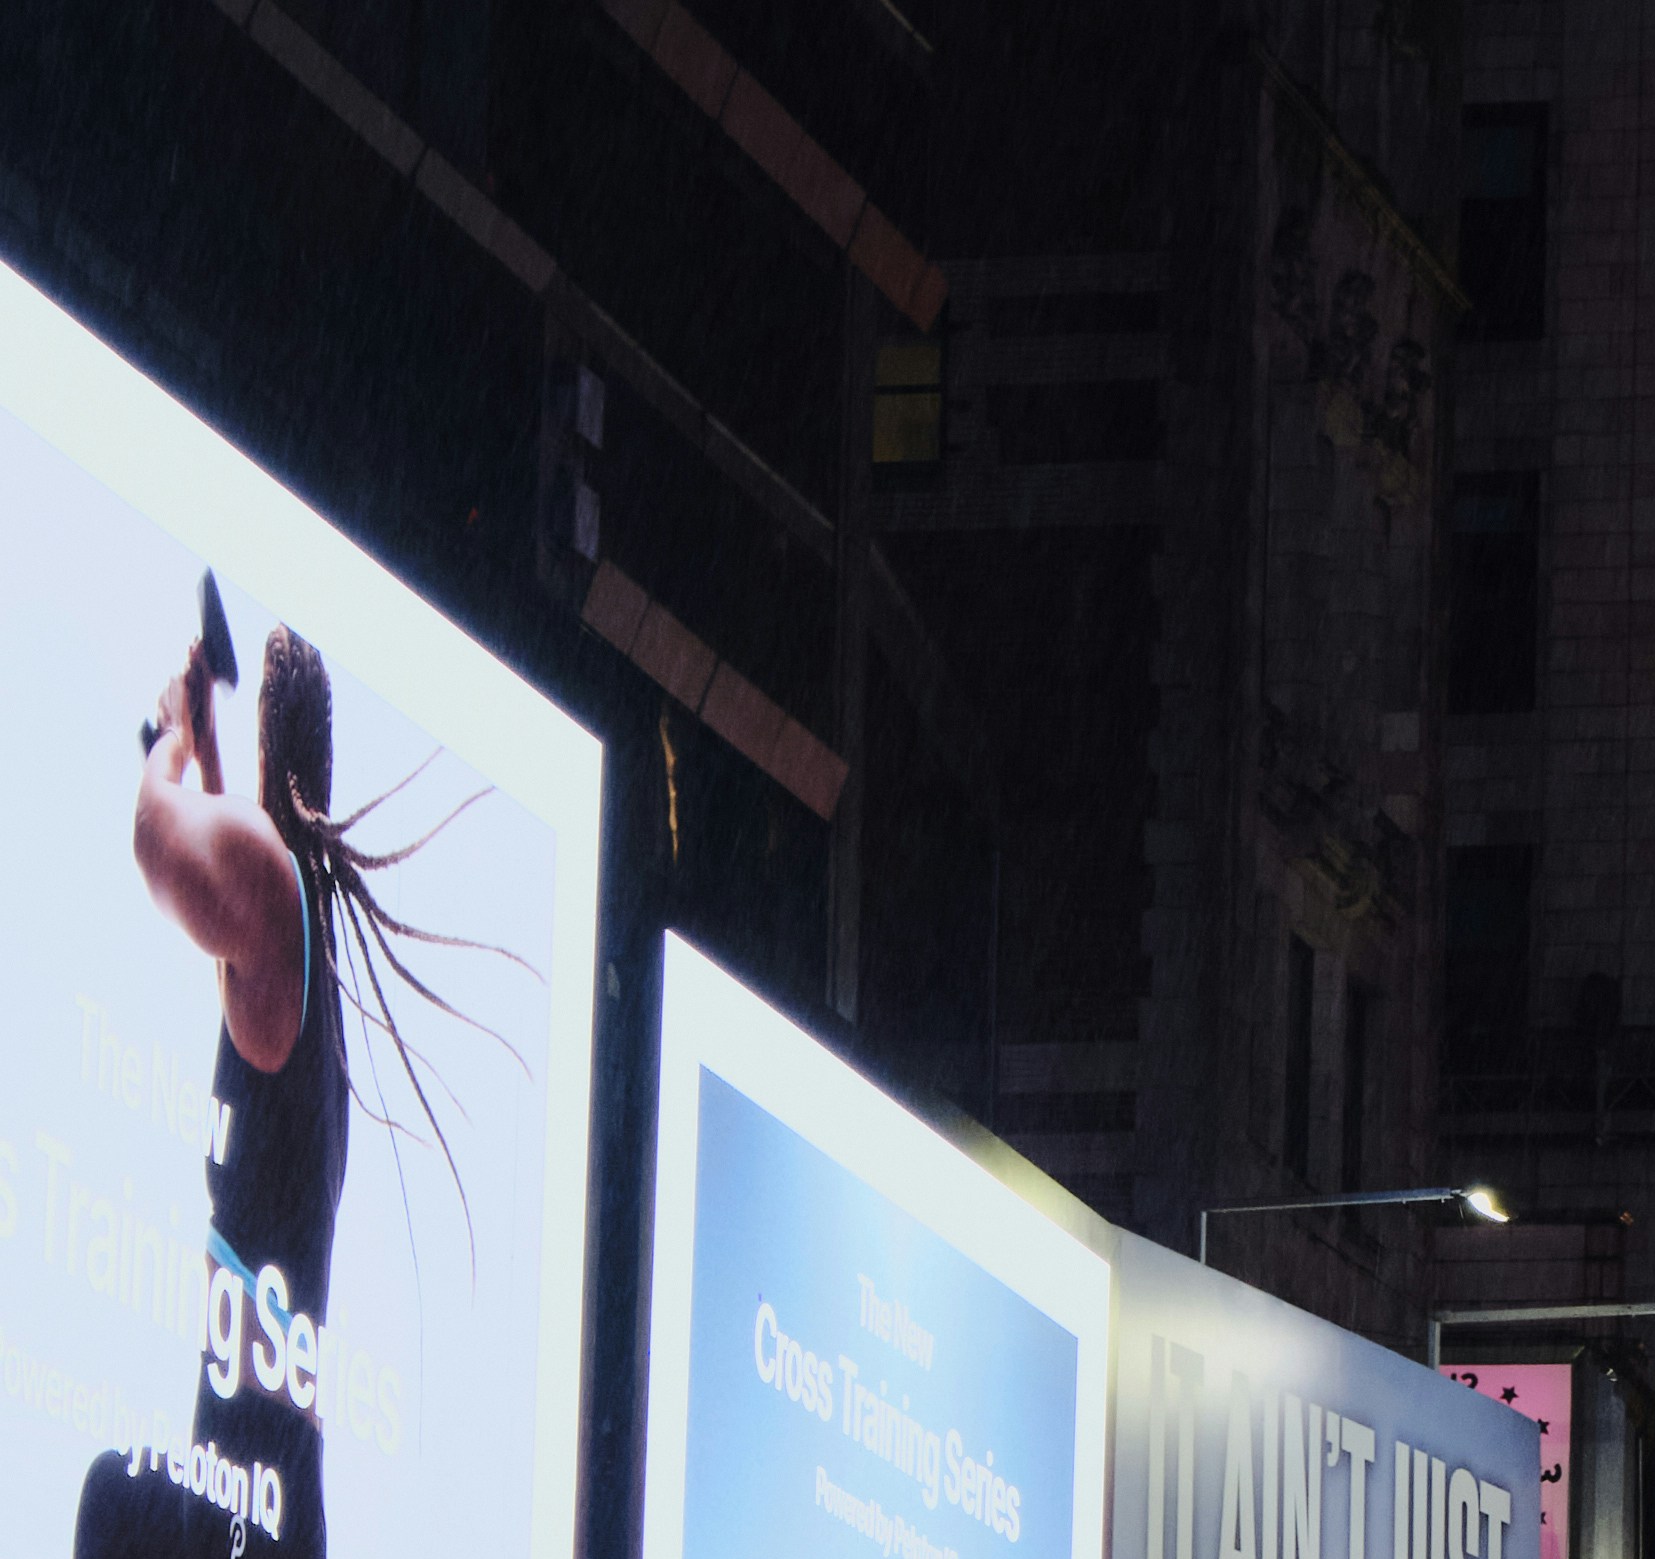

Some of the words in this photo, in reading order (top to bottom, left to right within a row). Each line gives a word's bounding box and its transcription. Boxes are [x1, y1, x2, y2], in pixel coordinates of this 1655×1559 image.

[754, 1301, 834, 1423] Cross
[838, 1353, 941, 1511] Training
[944, 1427, 1021, 1544] Series
